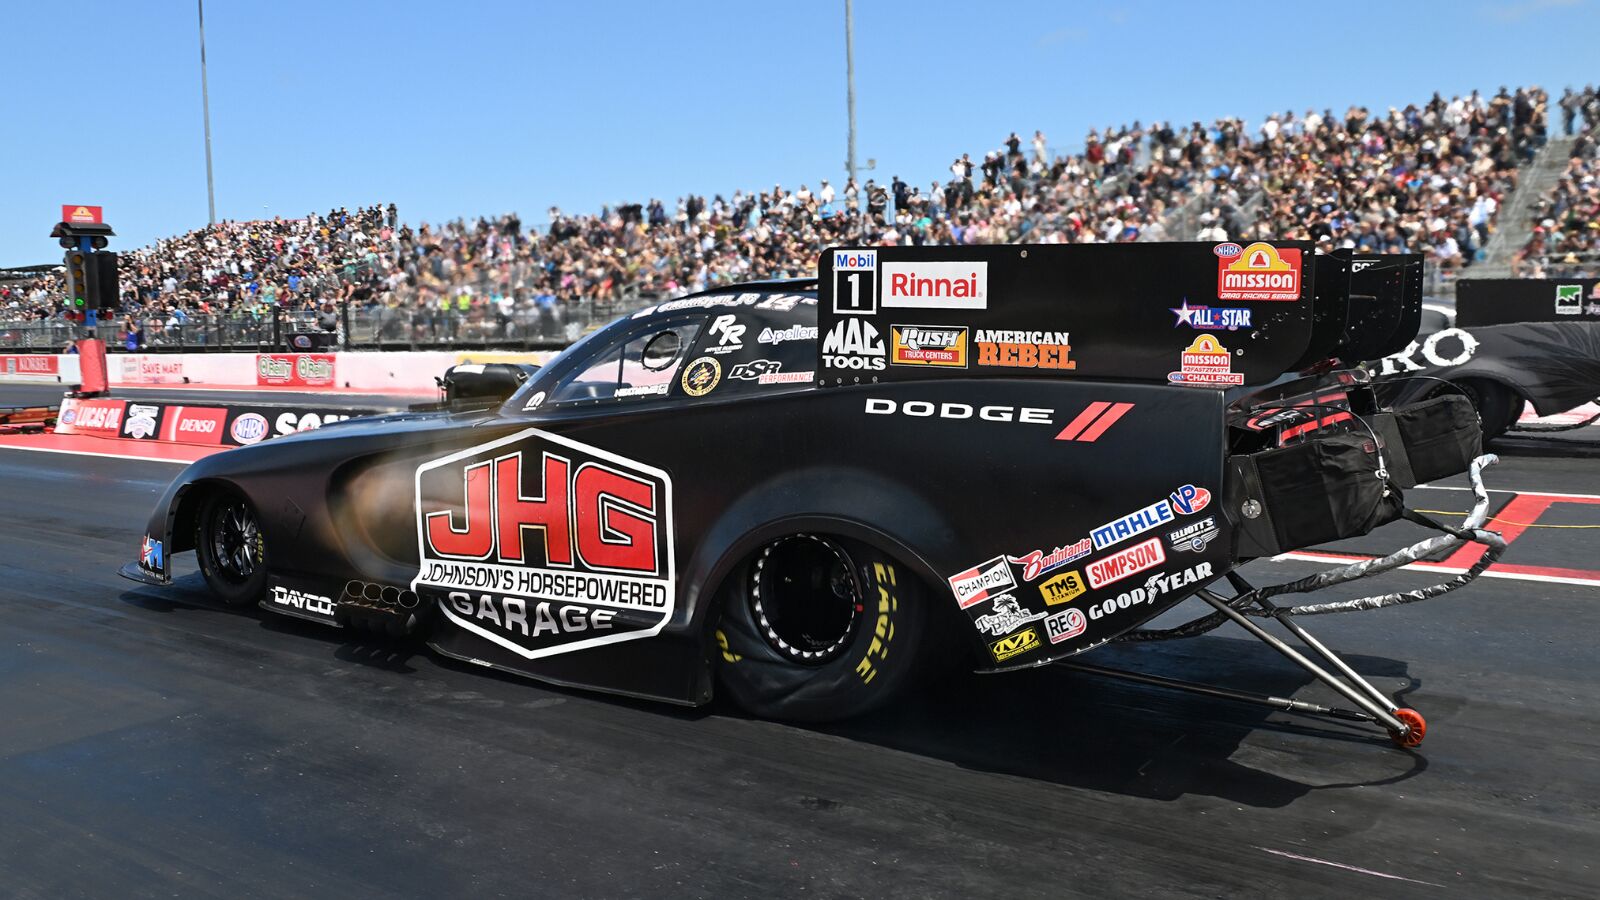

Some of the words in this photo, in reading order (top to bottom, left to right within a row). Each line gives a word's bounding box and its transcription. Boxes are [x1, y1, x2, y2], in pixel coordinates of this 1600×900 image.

[837, 254, 874, 268] Mobil
[1218, 245, 1239, 256] NHRA
[847, 273, 860, 308] 1
[891, 272, 977, 298] Rinnai
[1225, 274, 1293, 288] MISSION
[1193, 309, 1215, 326] ALL
[1221, 309, 1251, 327] STAR
[822, 318, 886, 355] MAC
[899, 327, 960, 351] RUSH
[974, 329, 1070, 346] AMERICAN
[822, 355, 886, 371] TOOLS
[904, 350, 925, 360] TRUCK
[926, 350, 953, 361] CENTERS
[977, 342, 1077, 370] REBEL
[1184, 355, 1228, 365] MISSION
[727, 359, 782, 380] DSR
[759, 372, 814, 384] PERFORMANCE
[1187, 374, 1241, 383] CHALLENGE
[75, 406, 106, 428] LUCAS
[104, 408, 122, 429] OIL
[864, 398, 1055, 424] DODGE
[179, 418, 217, 433] DENSO
[234, 417, 264, 440] NHRA
[1170, 484, 1197, 514] VP
[425, 451, 660, 577] JHG
[1092, 502, 1173, 548] MAHLE
[1170, 517, 1214, 541] ELLIOTT'S
[1091, 540, 1159, 585] SIMPSON
[422, 563, 514, 590] JOHNSON'S
[518, 572, 667, 608] HORSEPOWERED
[957, 568, 1008, 597] CHAMPION
[1045, 575, 1078, 597] TMS
[271, 586, 336, 616] DAYCO
[1051, 587, 1081, 602] TITANIUM
[448, 592, 618, 638] GARAGE
[856, 562, 897, 685] EAGLE
